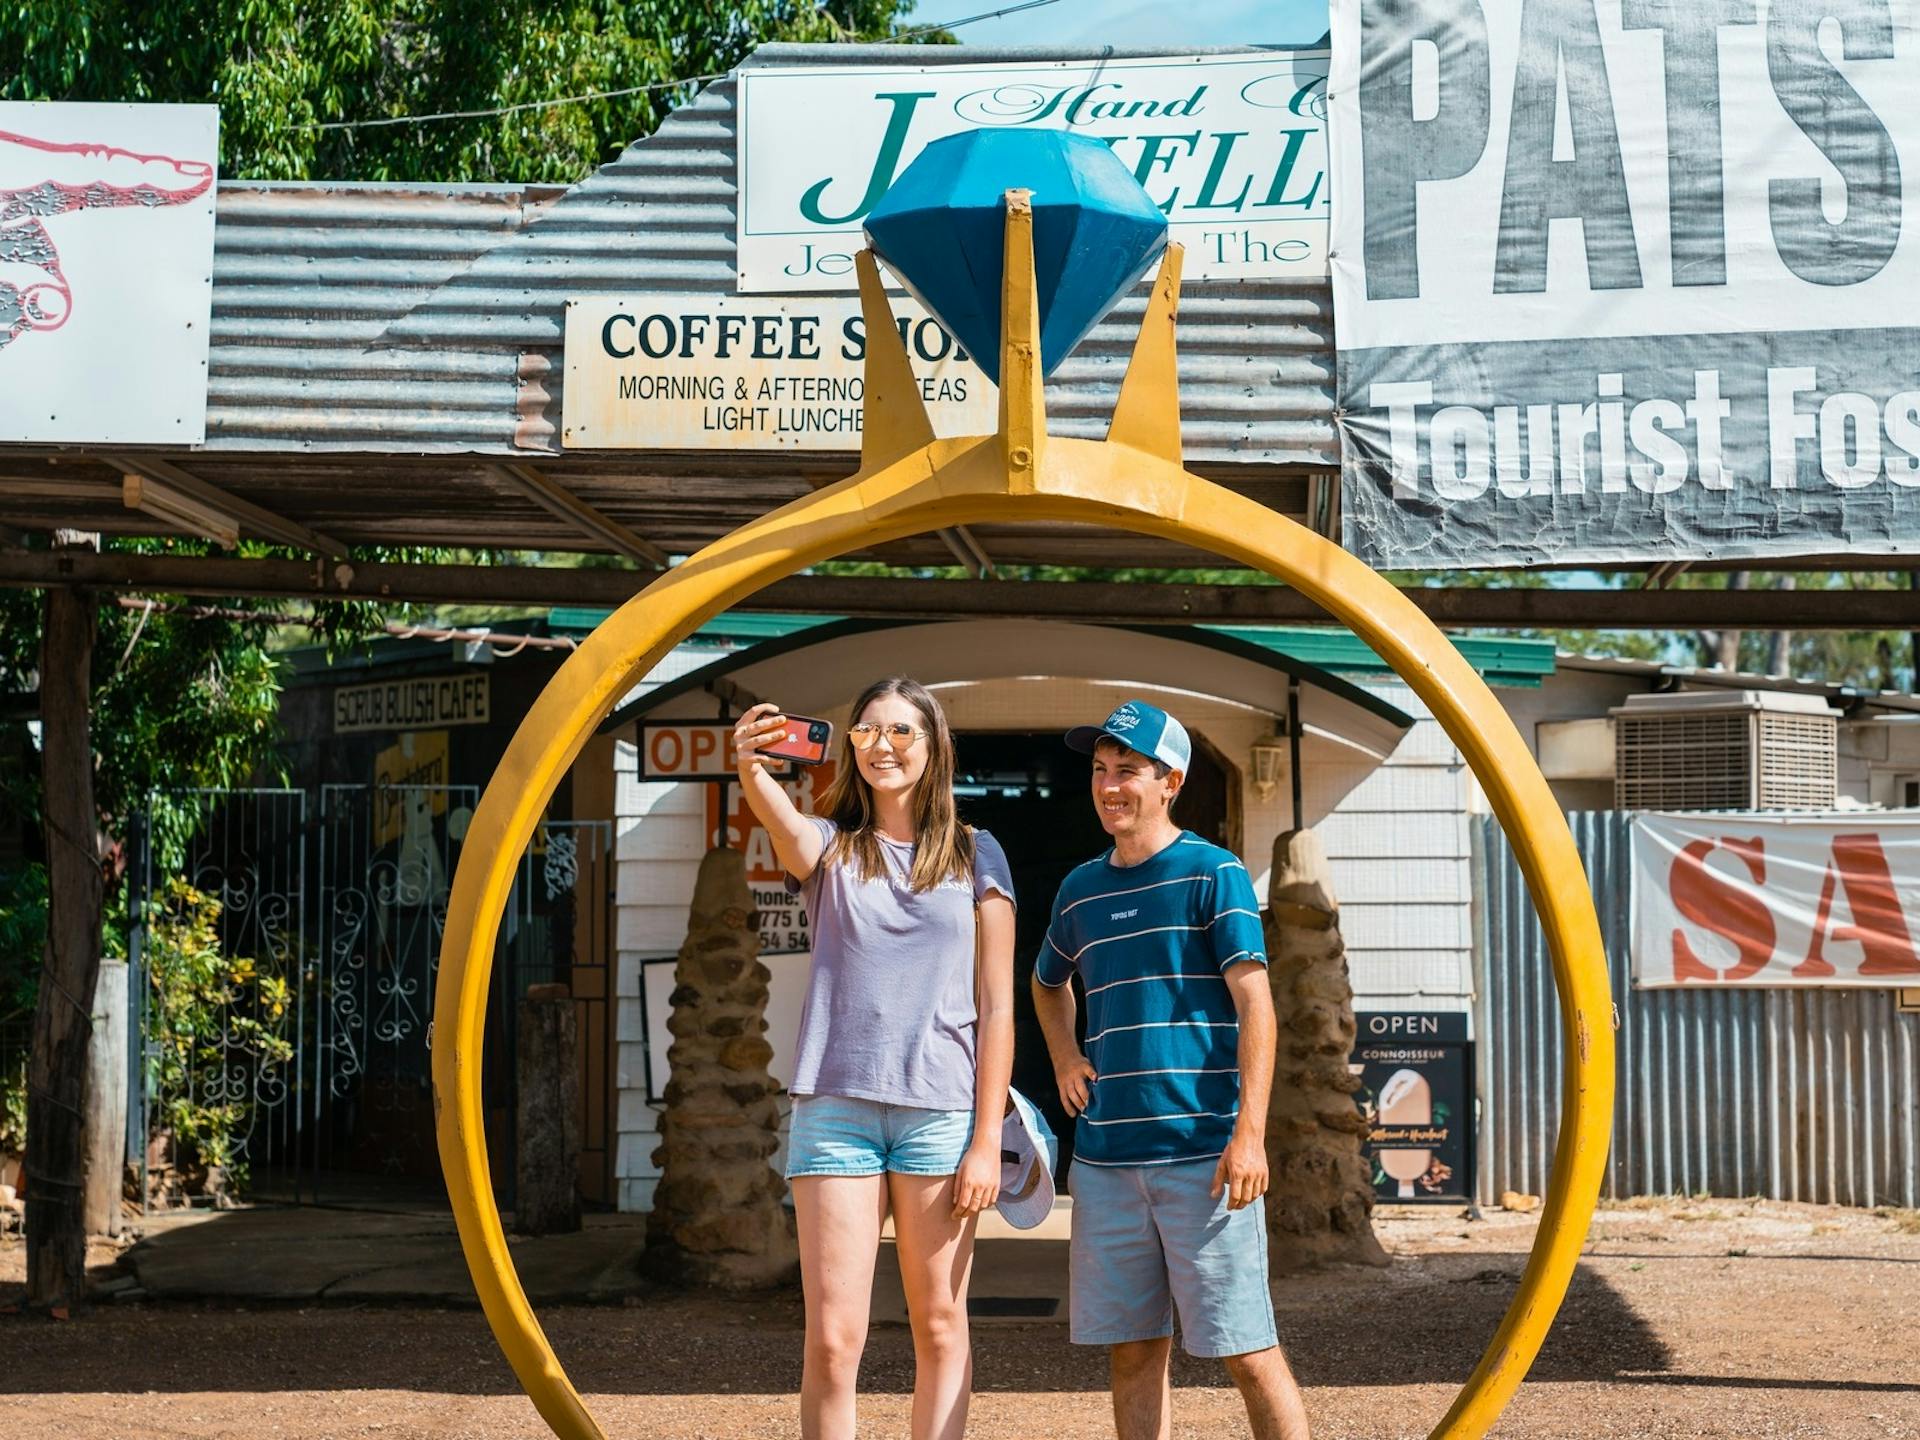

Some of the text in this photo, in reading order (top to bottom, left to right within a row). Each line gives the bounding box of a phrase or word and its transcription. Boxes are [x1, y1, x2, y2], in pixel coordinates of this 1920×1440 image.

[954, 82, 1208, 126] Hand
[1359, 0, 1903, 300] PATS
[1203, 229, 1312, 263] The
[601, 314, 821, 360] COFFEE
[619, 376, 725, 401] MORNING
[735, 377, 748, 400] &
[757, 378, 865, 402] AFTERNO
[703, 407, 865, 432] LIGHT LUNCHE
[1370, 369, 1734, 500] Tourist
[337, 676, 486, 727] SCRUB BLUSH CAFE
[753, 888, 799, 907] hone:
[1369, 1015, 1438, 1034] OPEN
[1362, 1049, 1446, 1060] CONNOISSEUR
